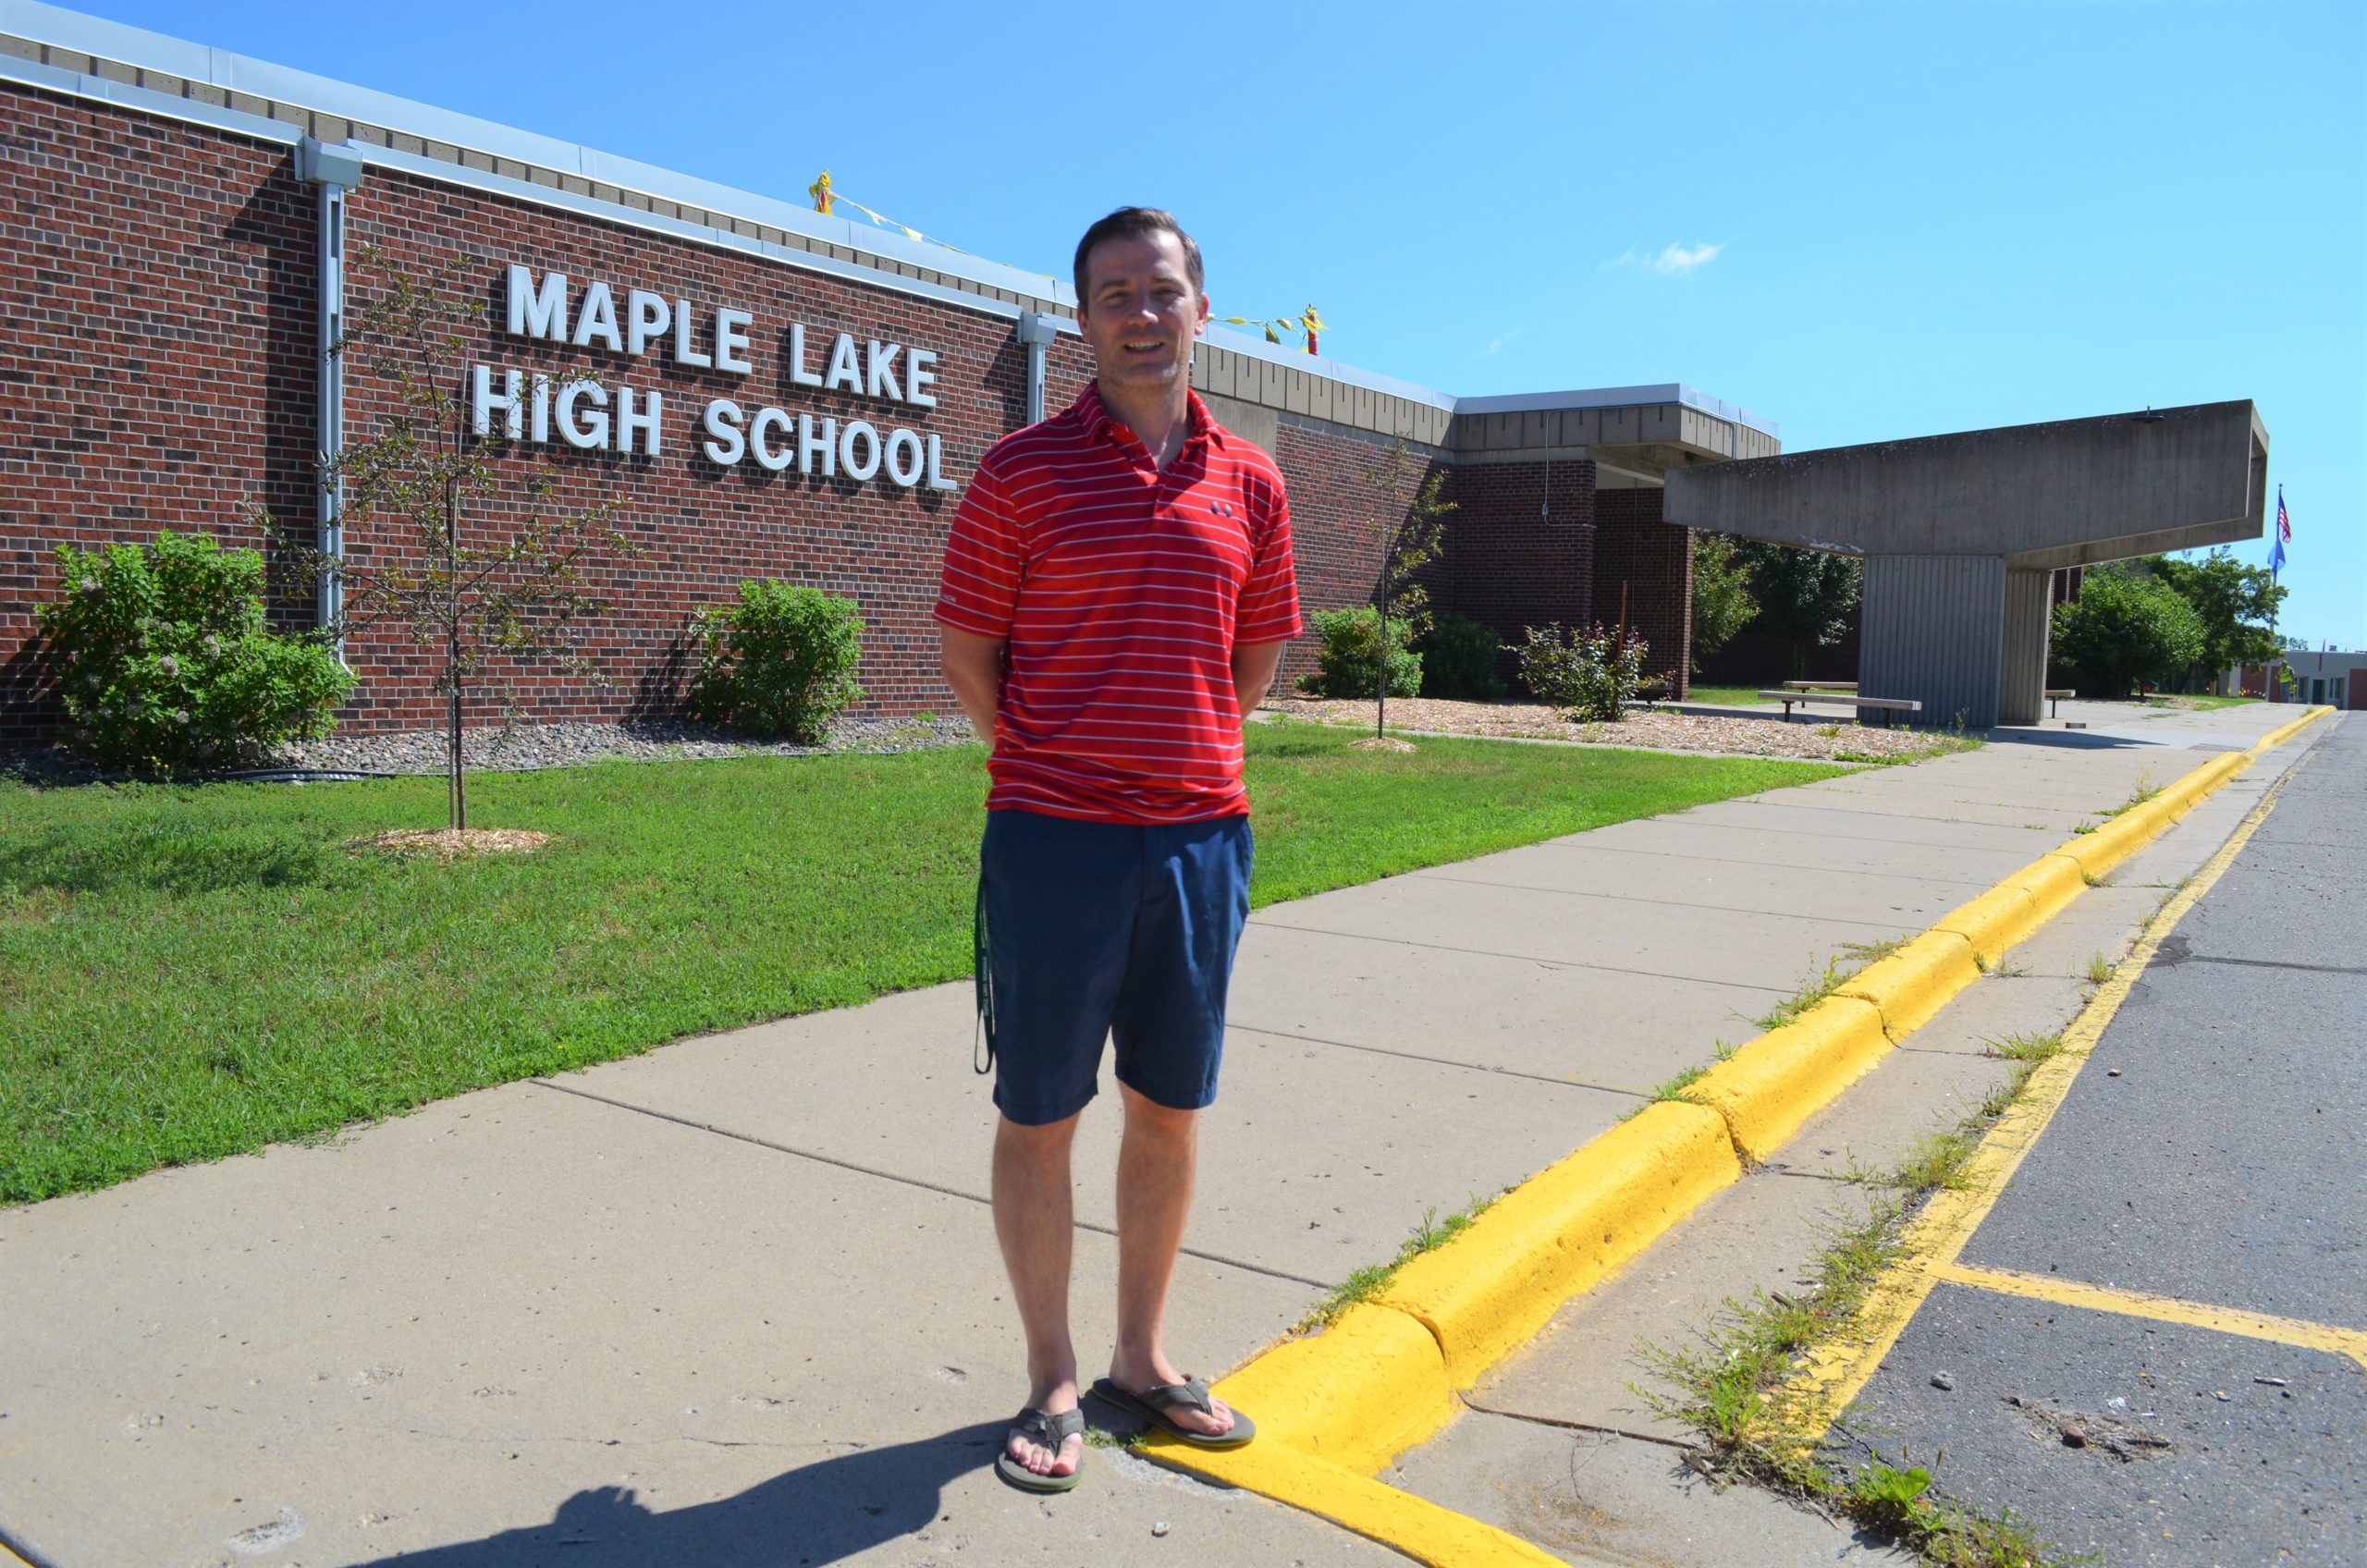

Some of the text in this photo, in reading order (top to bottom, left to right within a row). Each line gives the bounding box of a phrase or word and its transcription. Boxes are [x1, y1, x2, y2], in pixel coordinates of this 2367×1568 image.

[508, 263, 938, 407] MAPLE LAKE
[472, 364, 958, 491] HIGH SCHOOL
